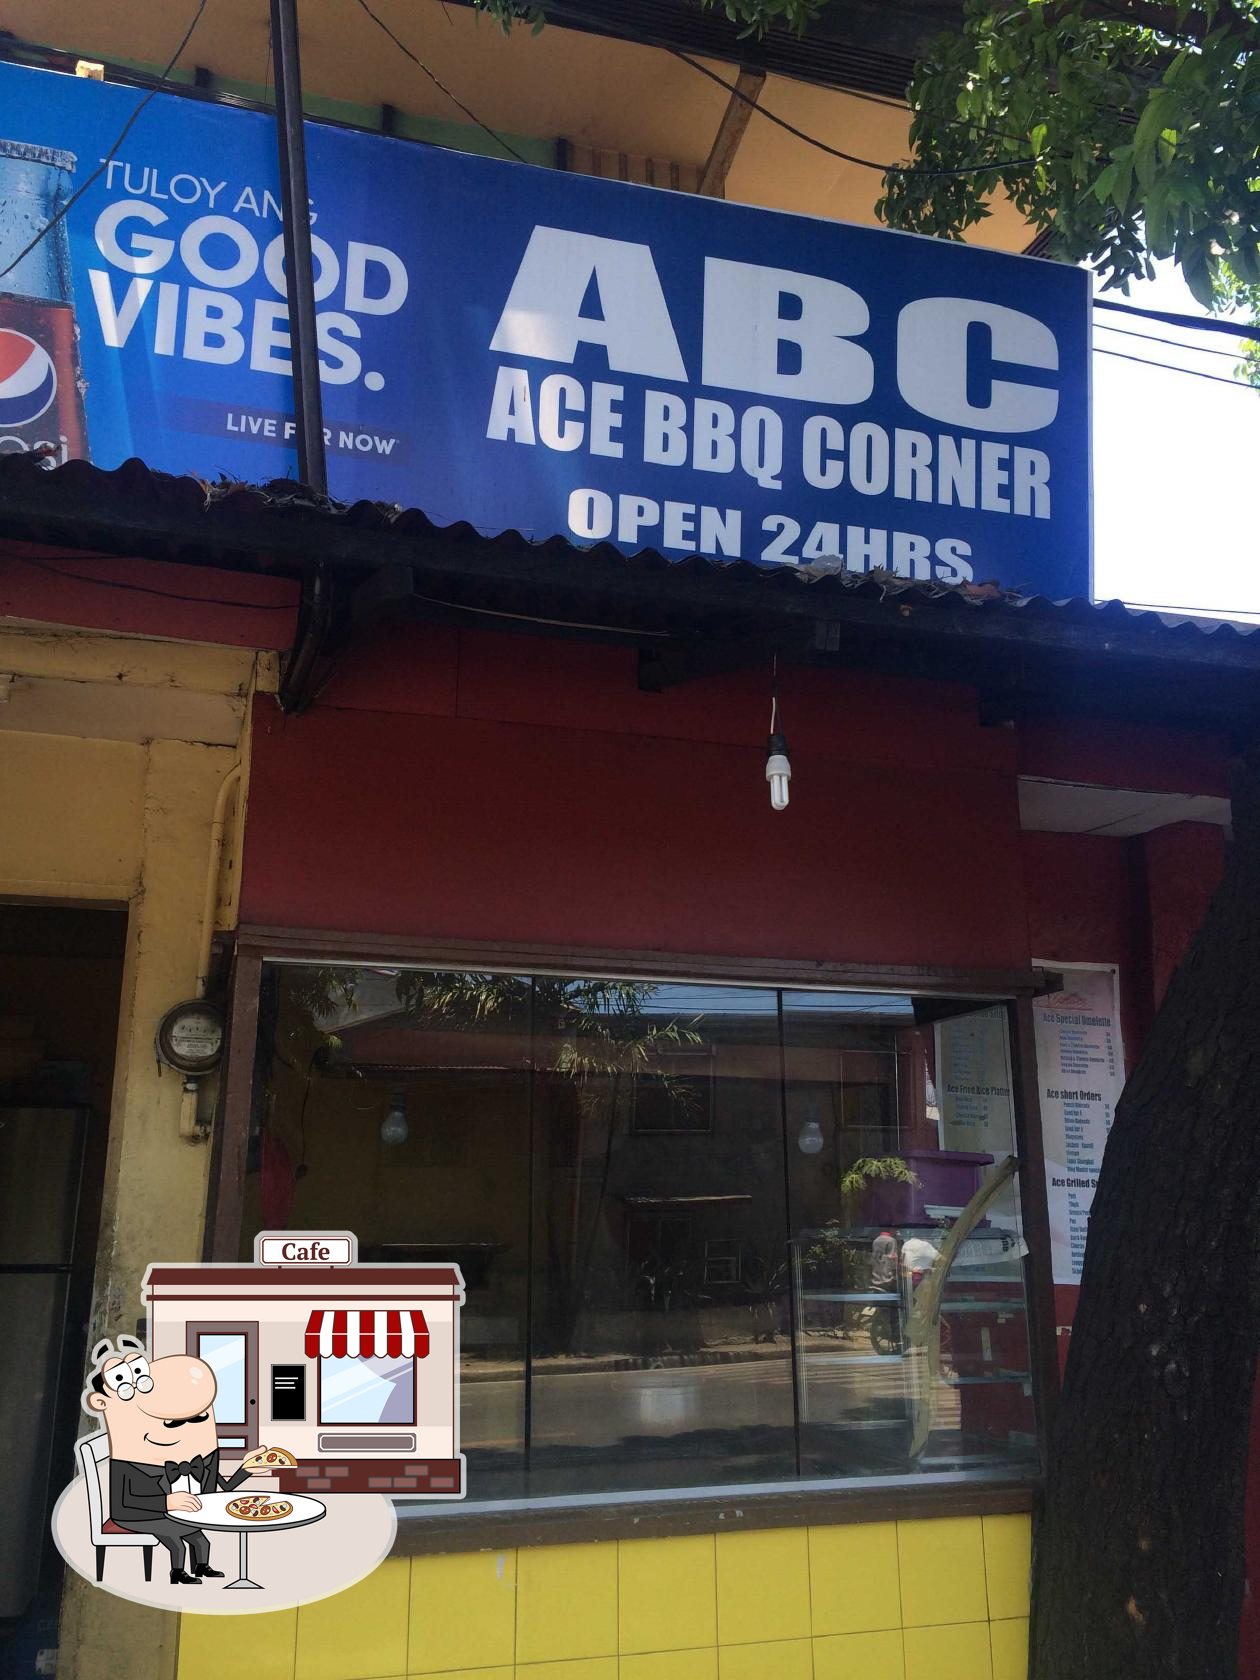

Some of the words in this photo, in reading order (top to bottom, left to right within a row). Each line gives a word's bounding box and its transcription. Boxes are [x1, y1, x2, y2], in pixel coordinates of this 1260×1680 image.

[100, 159, 227, 208] TULOY
[94, 199, 409, 317] GOOD
[88, 268, 386, 392] VIBES.
[488, 224, 1060, 434] ABC
[226, 412, 277, 438] LIVE
[283, 421, 332, 447] FR
[338, 430, 396, 455] NOW
[485, 365, 625, 459] ACE
[643, 389, 784, 491] BBQ
[802, 415, 1052, 520] CORNER
[567, 488, 742, 558] OPEN
[760, 514, 974, 586] 24HRS
[1046, 1088, 1060, 1099] Ace
[1052, 1177, 1066, 1187] Ace
[1066, 1177, 1090, 1188] Grilled
